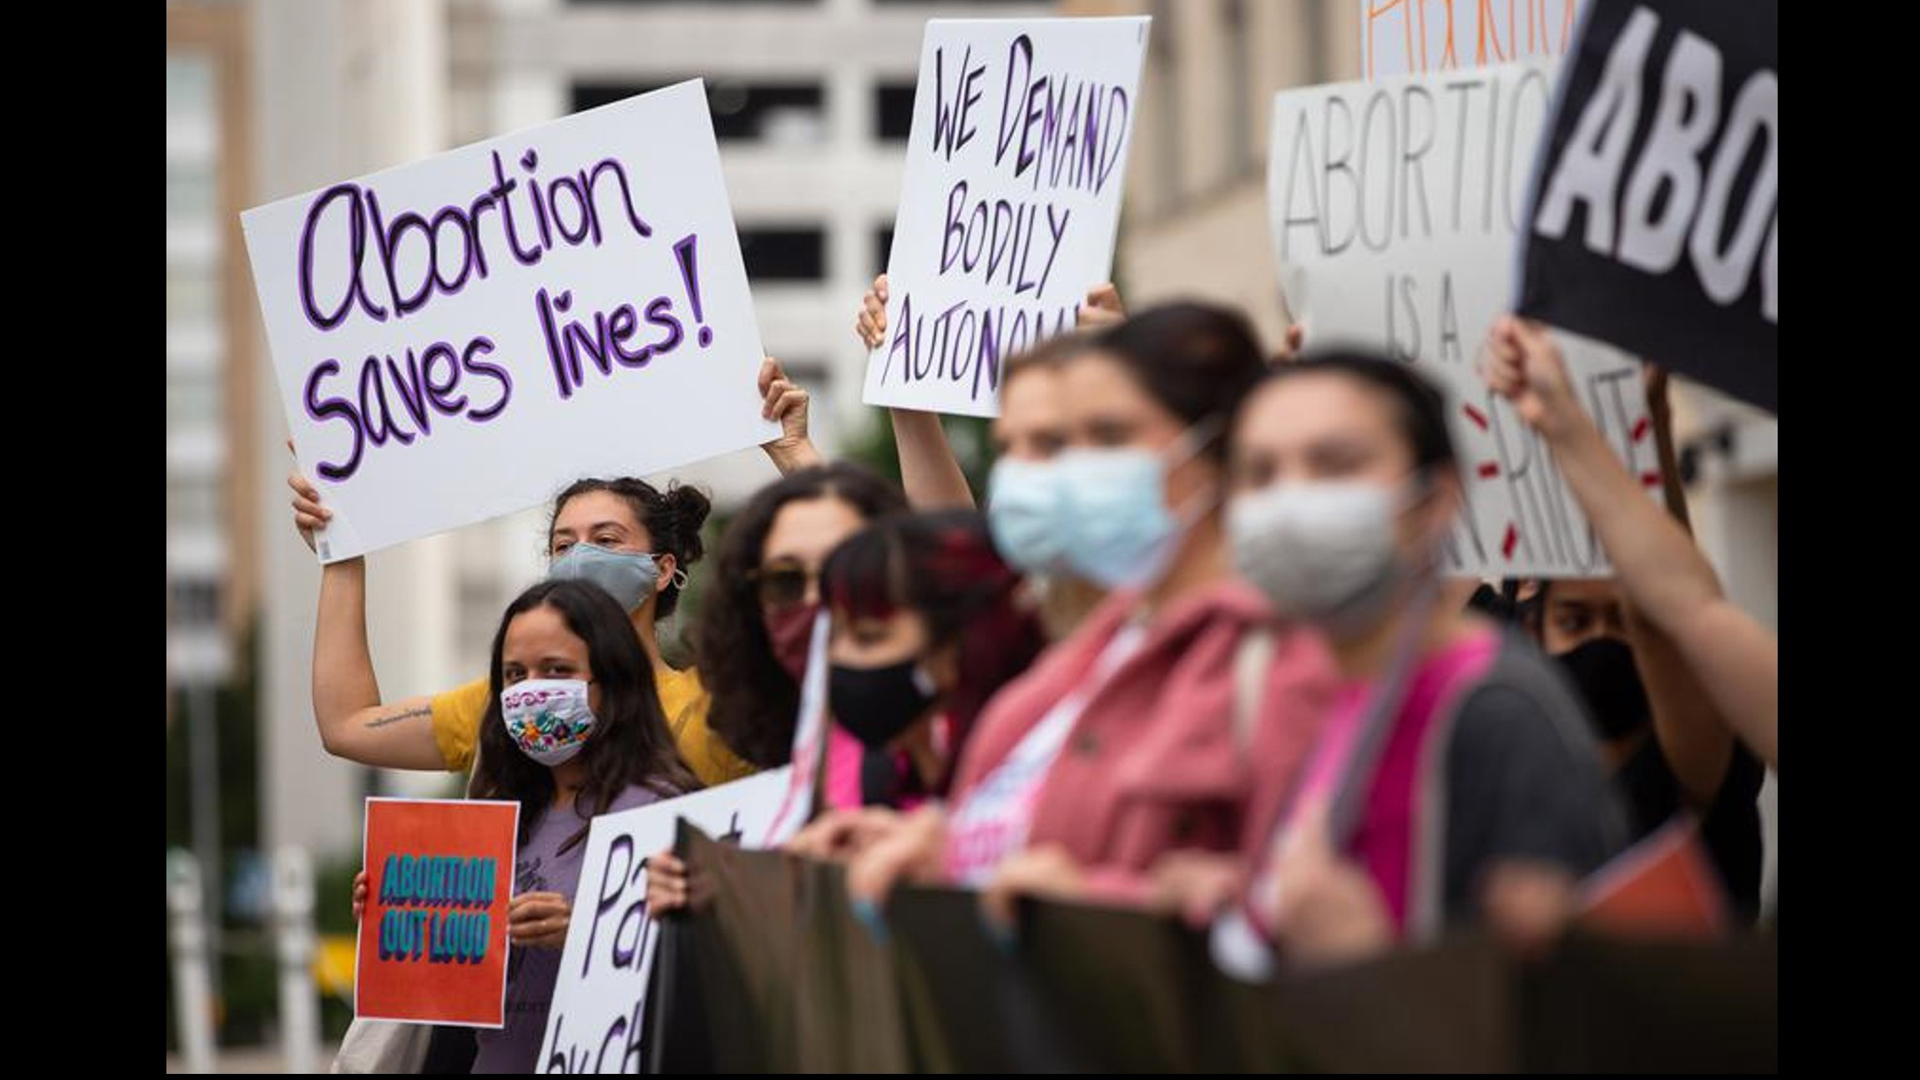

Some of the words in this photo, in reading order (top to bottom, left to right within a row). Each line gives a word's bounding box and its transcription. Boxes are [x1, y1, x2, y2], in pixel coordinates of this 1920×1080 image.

[933, 45, 986, 162] WE
[994, 33, 1128, 196] DEMAND
[1281, 69, 1550, 260] ABORTIO
[1535, 4, 1777, 325] ABO
[939, 179, 1070, 300] BODILY
[533, 232, 713, 399] lives!
[880, 292, 1079, 401] AUTONO
[1385, 273, 1422, 364] IS
[1439, 271, 1462, 362] A
[378, 854, 497, 910] ABORTION
[379, 909, 428, 962] OUT
[428, 910, 490, 964] LOUD
